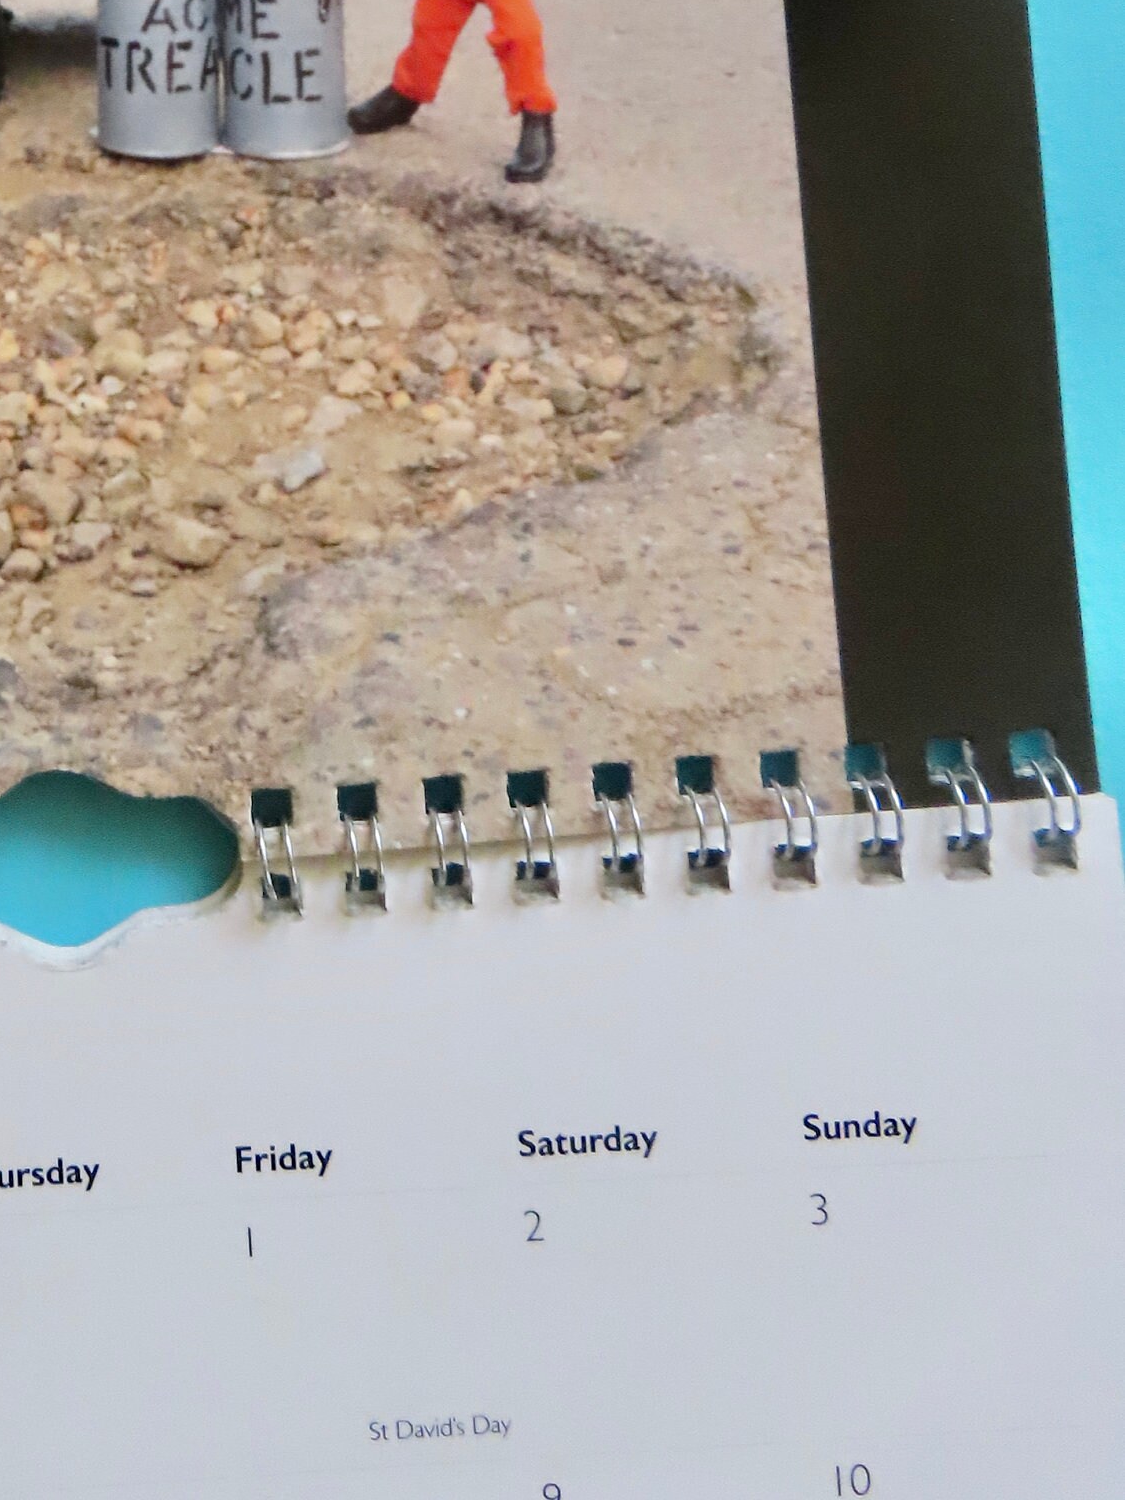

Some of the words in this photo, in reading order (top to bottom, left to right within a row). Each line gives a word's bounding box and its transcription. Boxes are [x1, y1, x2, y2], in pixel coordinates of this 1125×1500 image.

[517, 1124, 658, 1159] Saturday
[801, 1109, 918, 1145] Sunday
[234, 1141, 333, 1177] Friday
[523, 1210, 545, 1243] 2
[809, 1192, 830, 1227] 3
[246, 1226, 254, 1259] 1
[368, 1420, 389, 1442] St
[395, 1417, 466, 1441] David's
[472, 1413, 512, 1439] Day
[834, 1463, 873, 1498] 10
